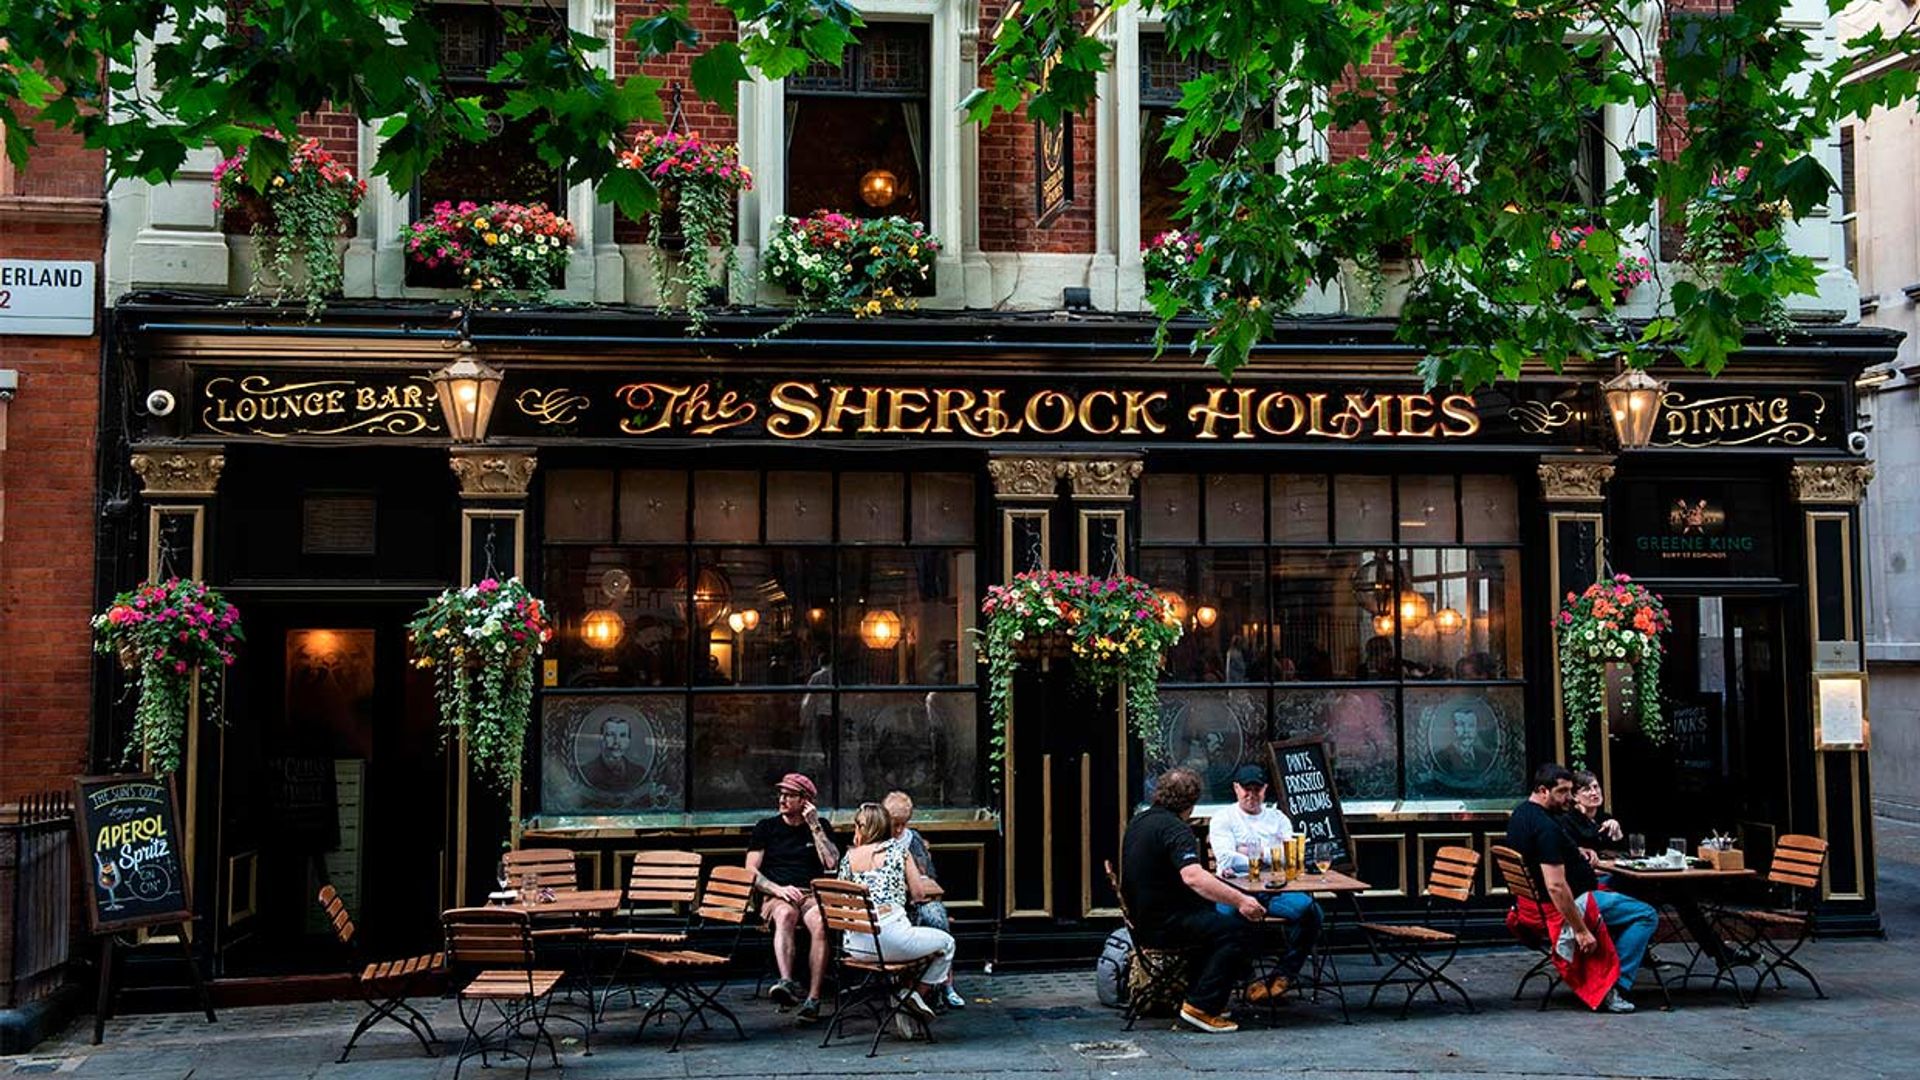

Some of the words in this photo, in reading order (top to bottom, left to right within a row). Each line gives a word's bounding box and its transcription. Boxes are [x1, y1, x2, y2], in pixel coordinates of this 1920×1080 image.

[1, 267, 82, 288] ERLAND
[216, 390, 346, 422] LOUNGE
[355, 384, 424, 411] BAR
[615, 382, 757, 435] The
[766, 381, 1168, 439] SHERLOCK
[1187, 386, 1481, 440] HOLMES
[1665, 397, 1790, 437] DINING
[1636, 536, 1704, 551] GREENE
[1709, 536, 1754, 551] KING
[1285, 771, 1325, 794] PROSECCO
[94, 793, 107, 805] THE
[139, 787, 158, 798] OUT
[1289, 797, 1298, 815] &
[97, 815, 167, 851] APEROL
[1324, 816, 1335, 838] 1
[119, 838, 169, 870] Spritz
